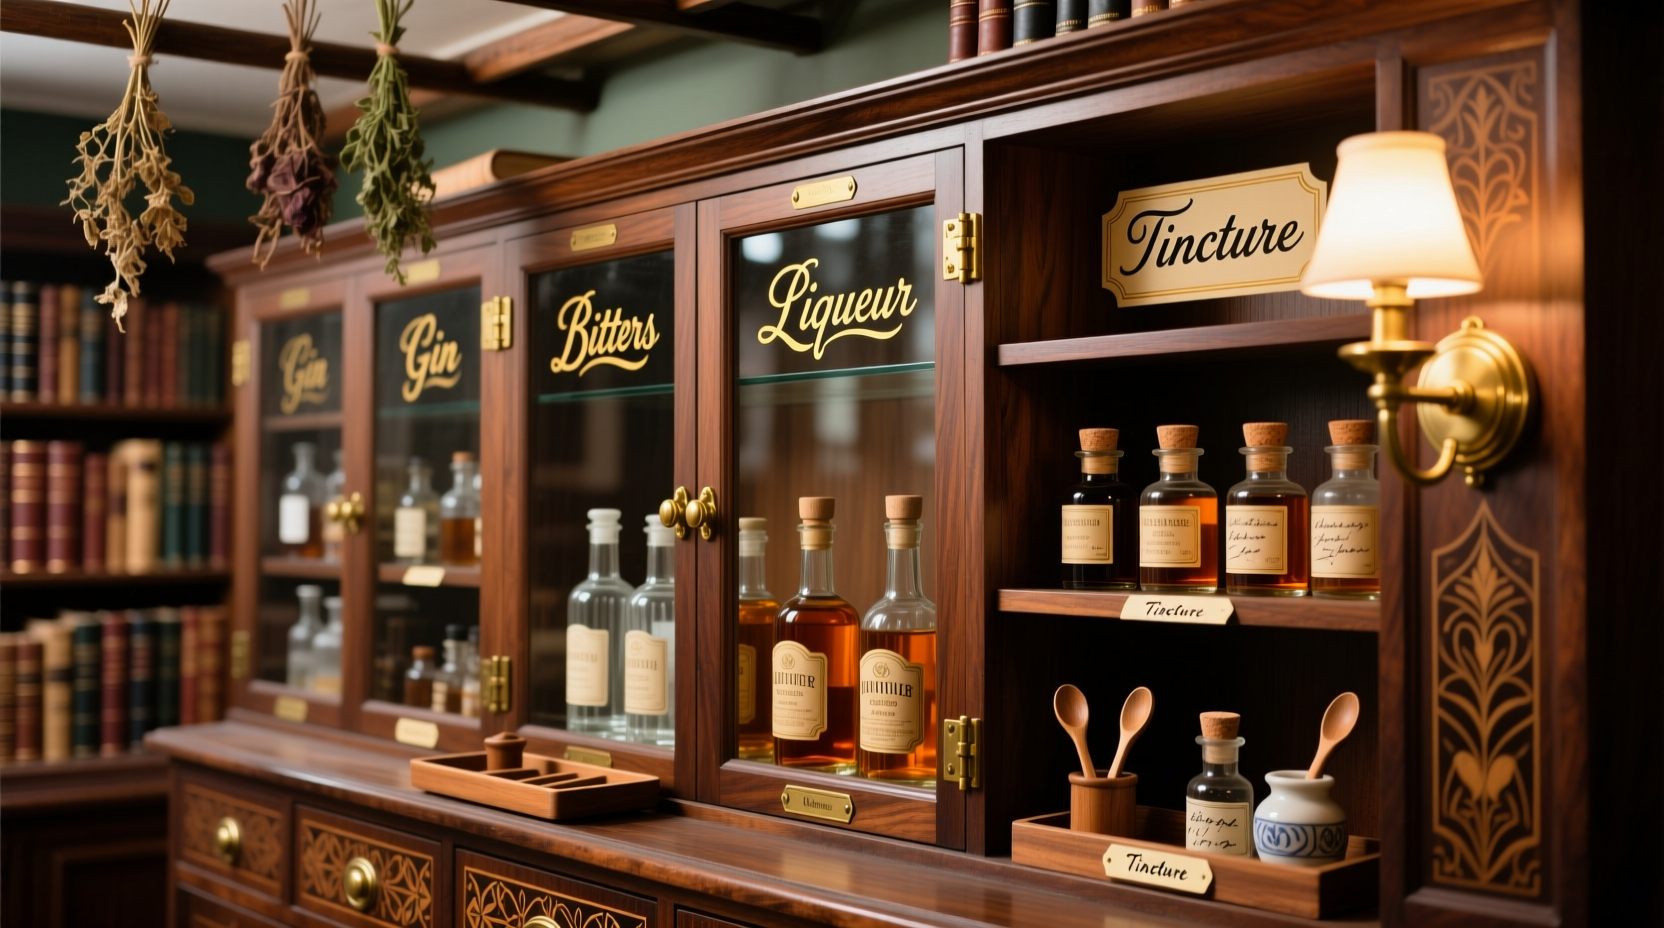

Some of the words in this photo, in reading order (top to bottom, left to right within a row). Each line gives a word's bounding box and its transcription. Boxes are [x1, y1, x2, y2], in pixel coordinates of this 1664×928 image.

[1119, 198, 1304, 276] Tincture
[551, 290, 660, 377] Bitters
[758, 258, 917, 360] Liqueur
[278, 333, 329, 415] Gin
[399, 313, 462, 402] Gin
